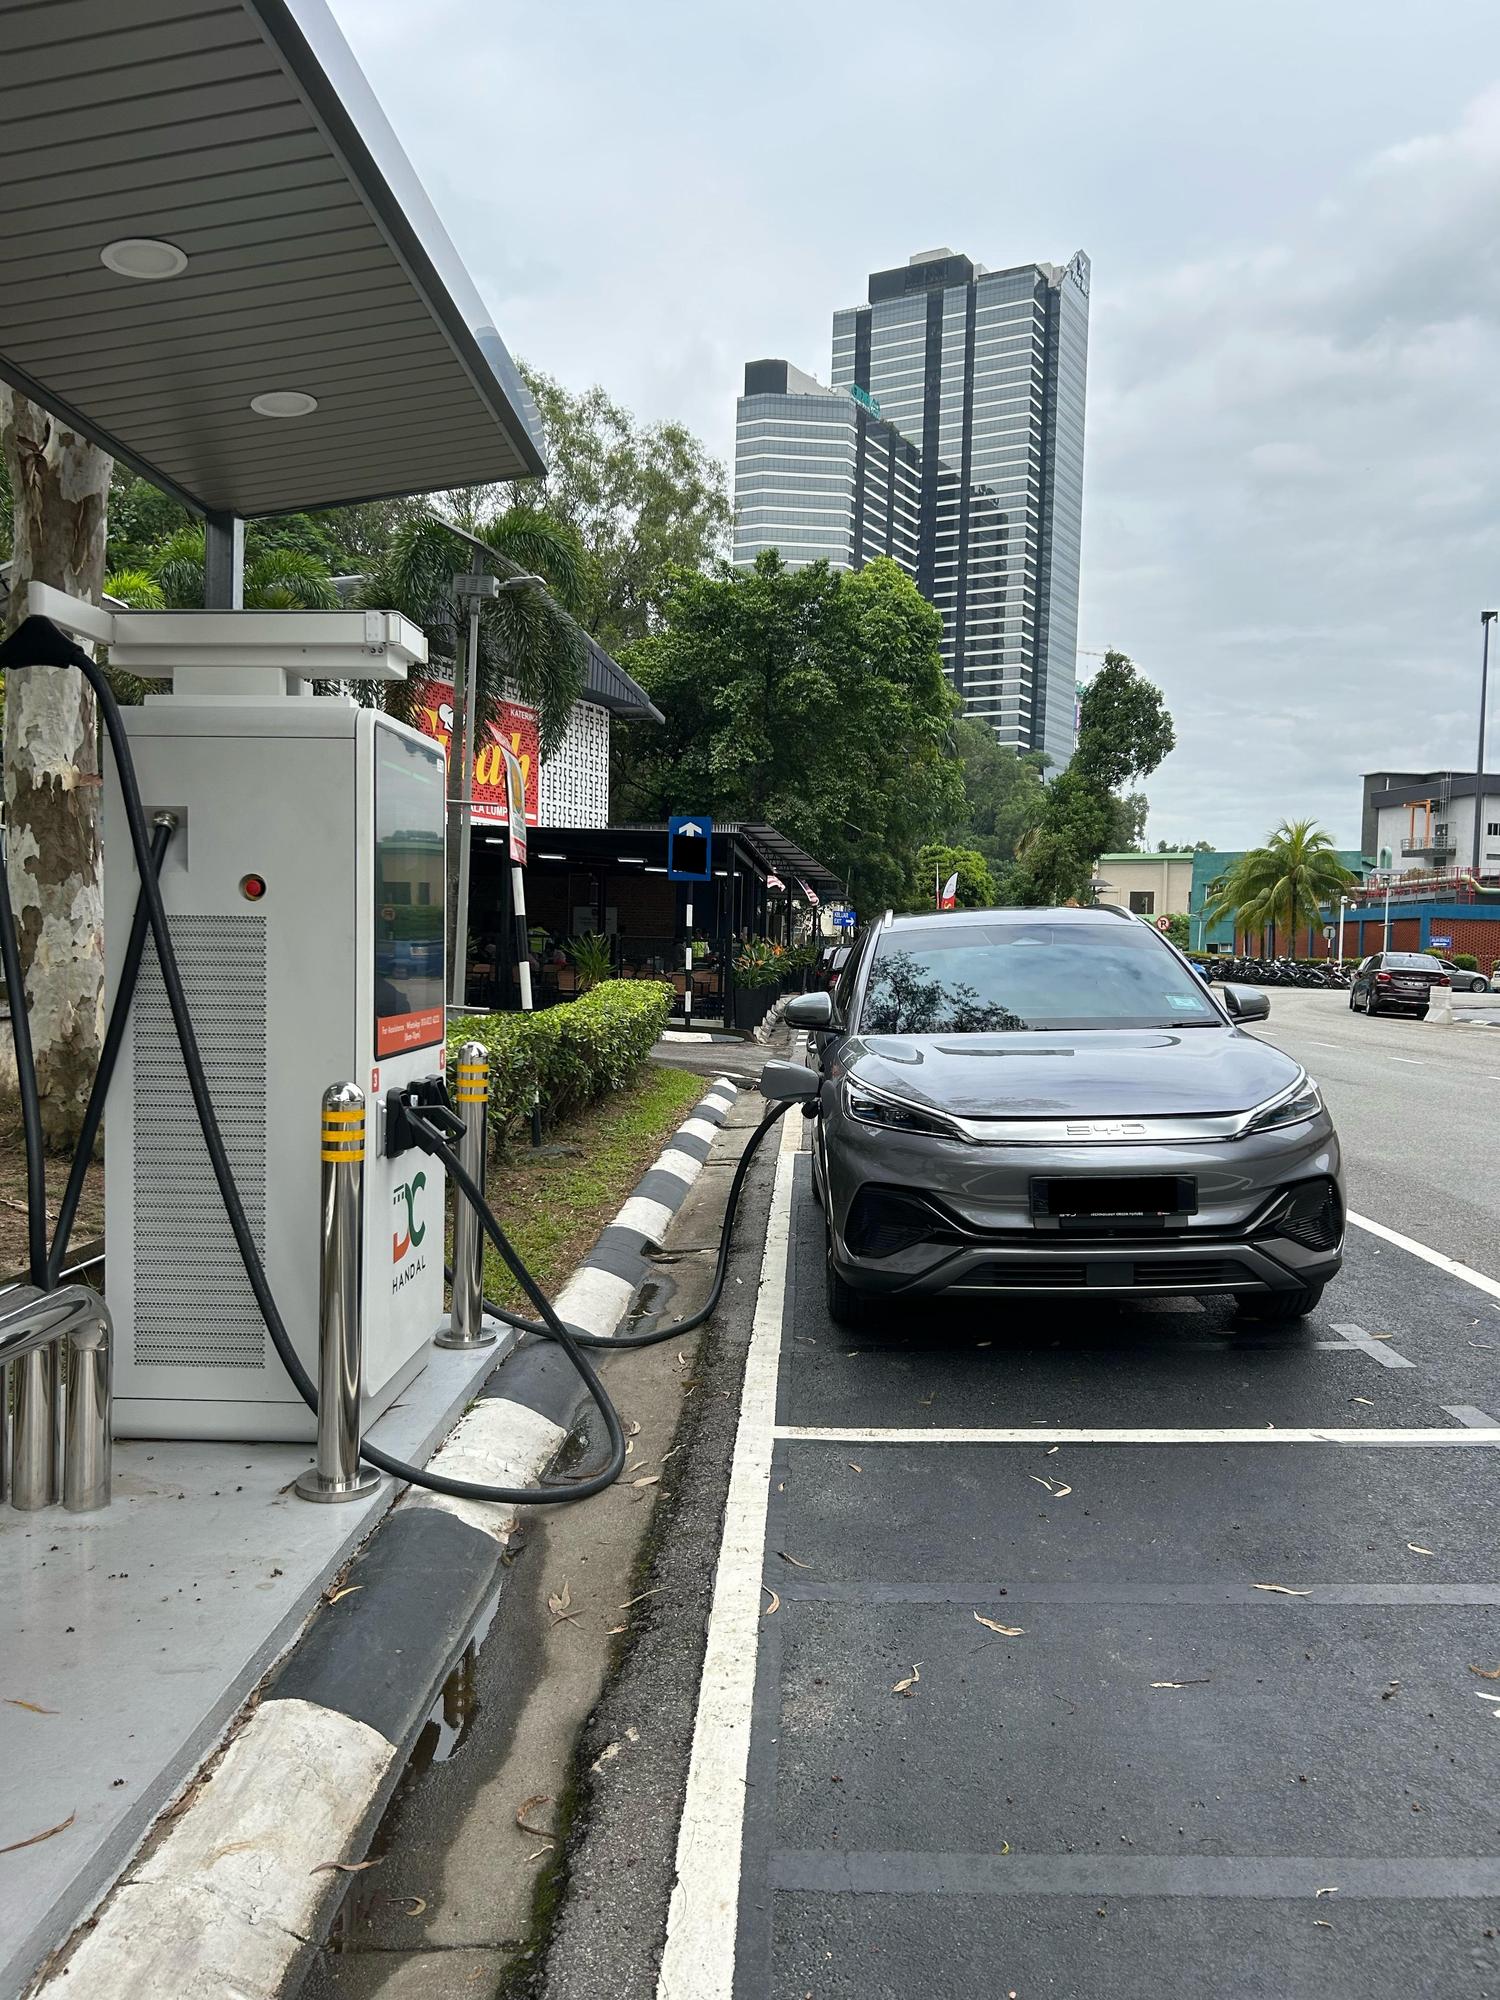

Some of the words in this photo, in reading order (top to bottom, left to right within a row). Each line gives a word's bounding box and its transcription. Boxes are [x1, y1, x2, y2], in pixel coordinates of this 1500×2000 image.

[486, 806, 508, 817] LUMP
[1066, 1123, 1146, 1136] BYD
[392, 1255, 426, 1295] HANDAL
